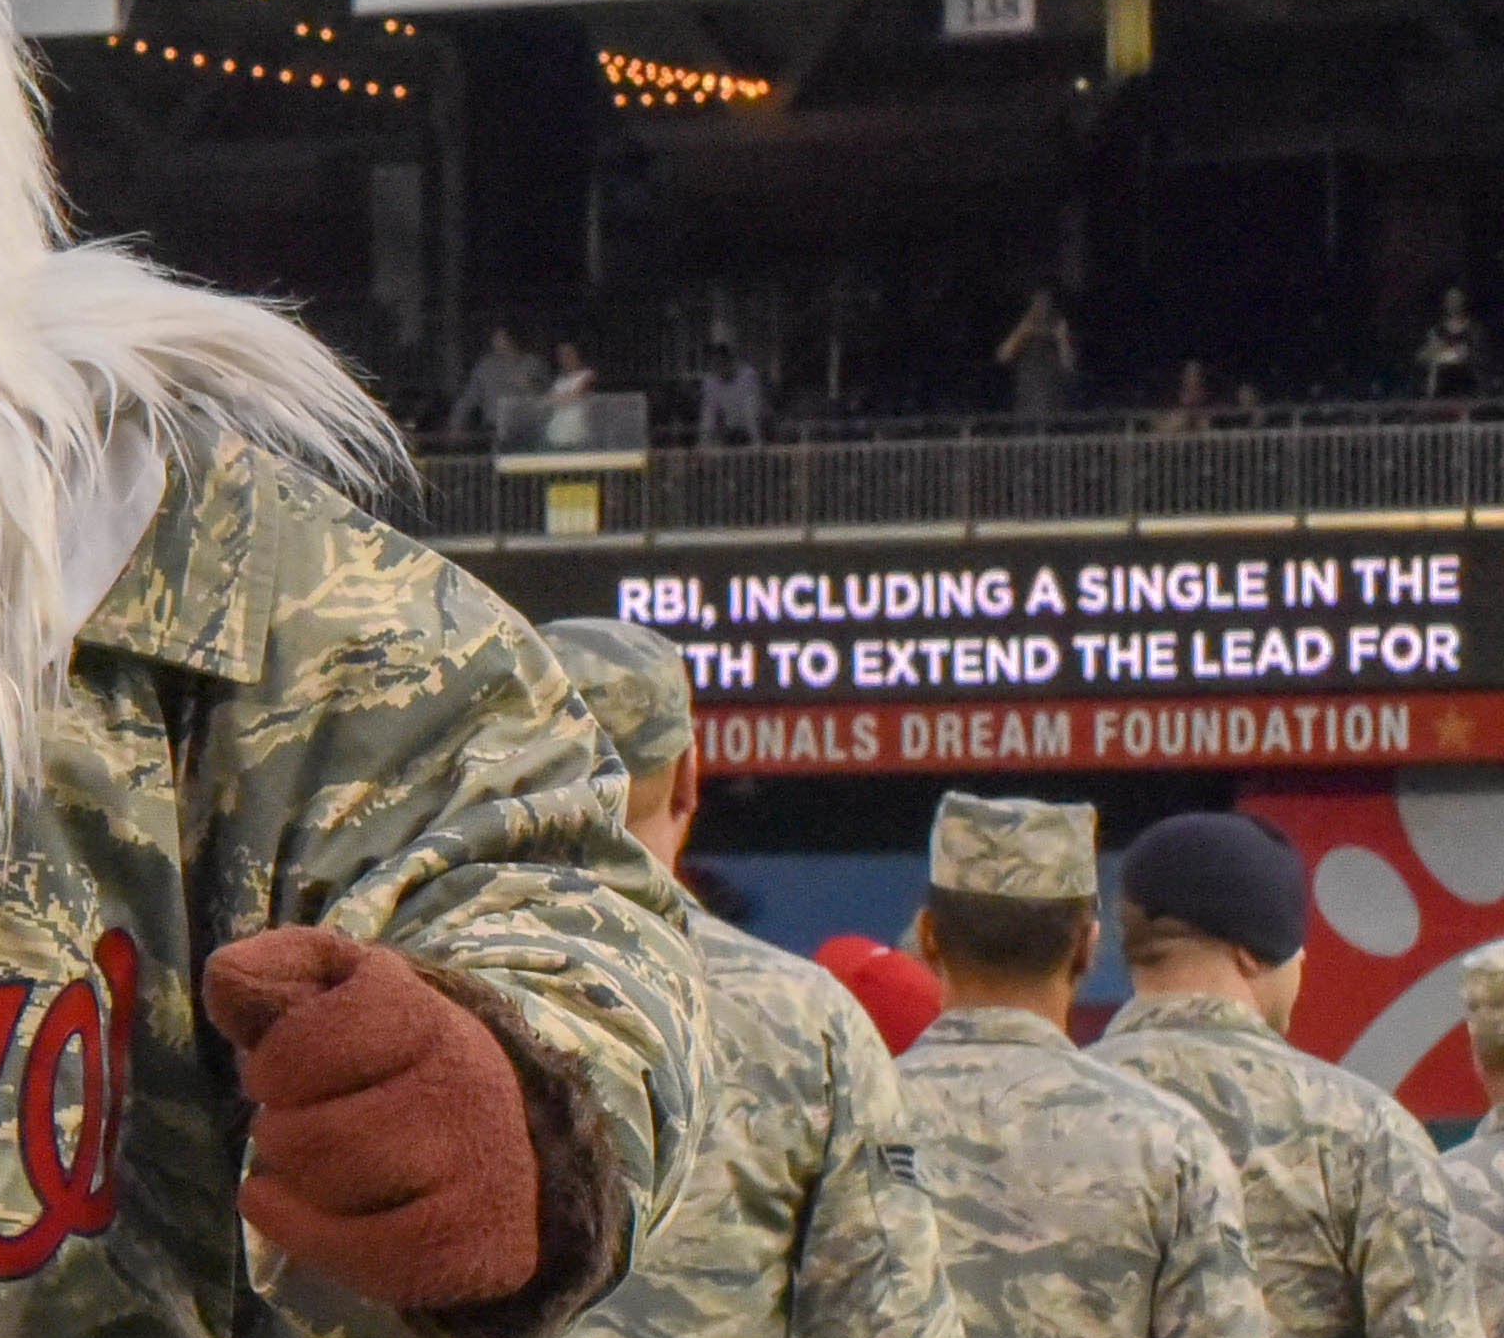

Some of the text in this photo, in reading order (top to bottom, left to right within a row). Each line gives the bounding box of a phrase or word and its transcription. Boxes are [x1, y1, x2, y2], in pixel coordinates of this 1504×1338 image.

[618, 554, 1462, 630] RBI, INCLUDING A SINGLE IN THE
[685, 622, 1461, 690] TH TO EXTEND THE LEAD FOR
[694, 703, 1411, 764] IONALS DREAM FOUNDATION
